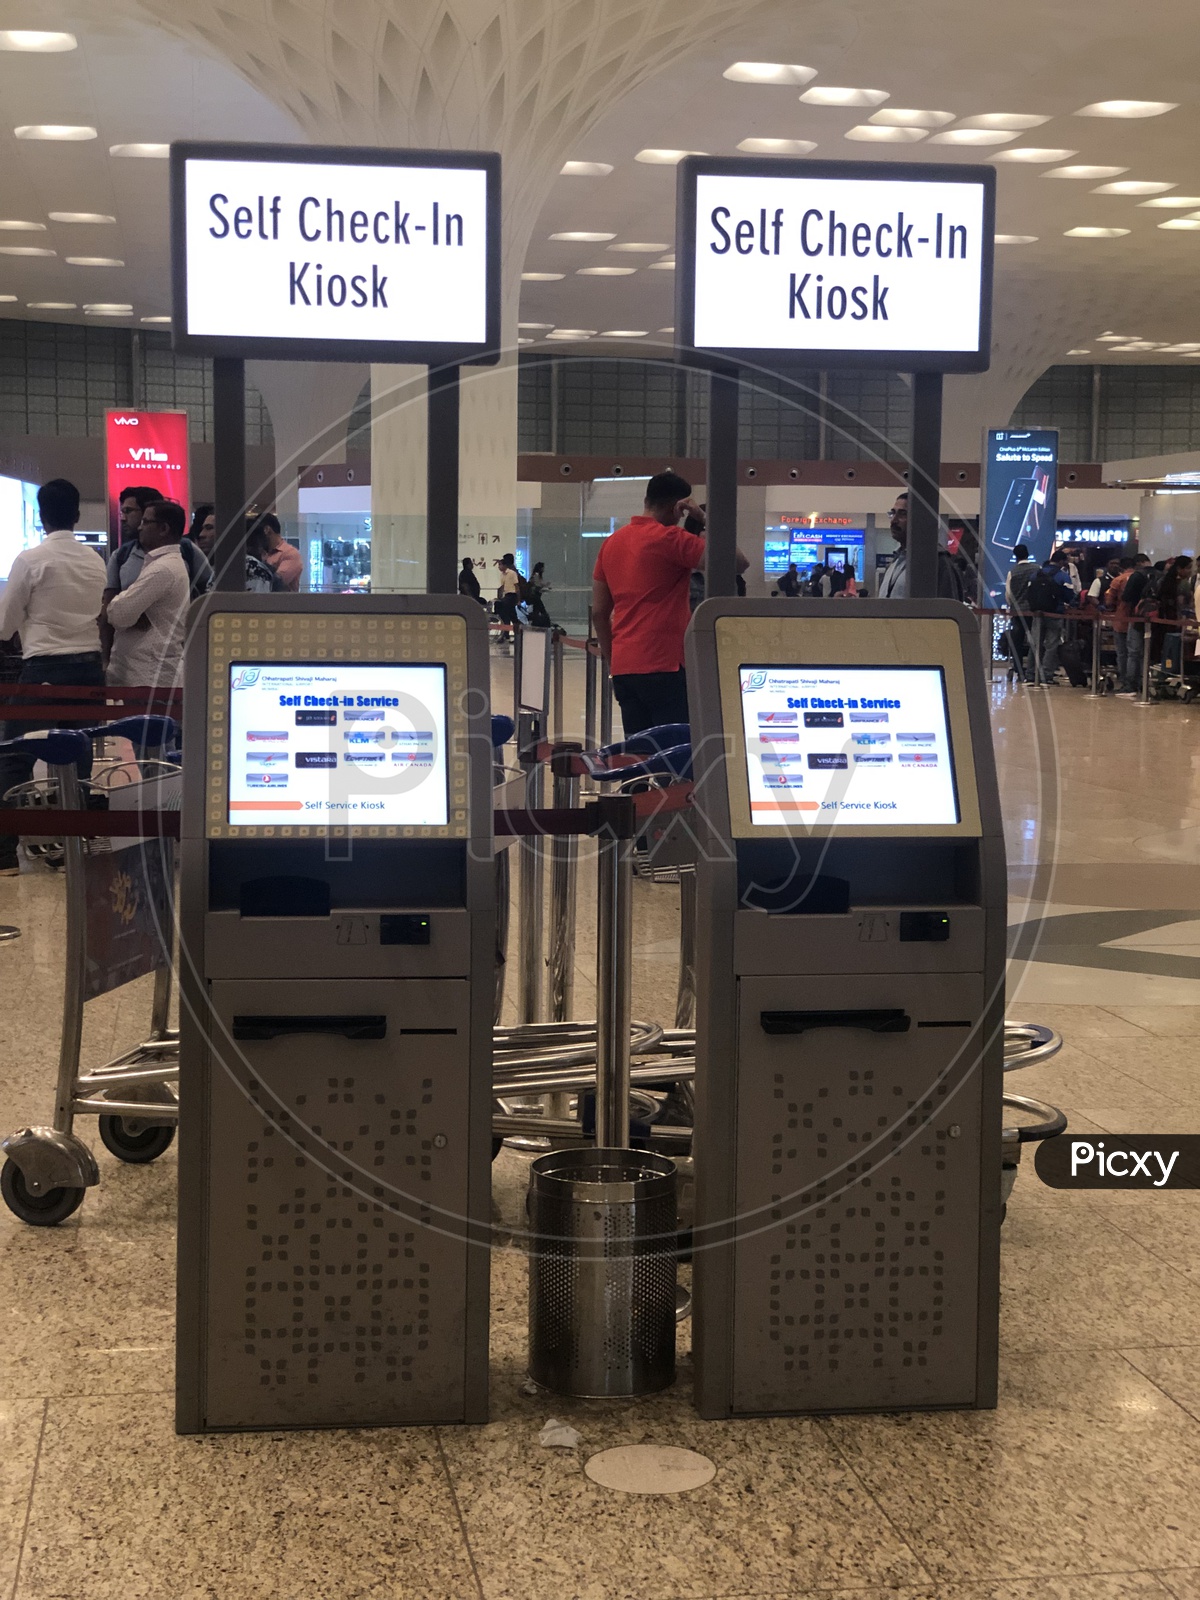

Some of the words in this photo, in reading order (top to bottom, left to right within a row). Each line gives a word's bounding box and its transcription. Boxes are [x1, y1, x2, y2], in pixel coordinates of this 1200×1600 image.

[208, 193, 281, 240] Self
[298, 196, 464, 246] Check-In
[709, 206, 784, 255] Self
[799, 208, 968, 259] Check-In
[289, 261, 388, 308] Kiosk
[788, 273, 890, 321] Kiosk
[995, 453, 1021, 462] Salute
[1022, 453, 1031, 462] to
[1031, 453, 1053, 463] Speed
[279, 695, 302, 706] Self
[304, 695, 355, 707] Check-in
[357, 695, 399, 707] Service
[787, 697, 808, 709] Self
[811, 697, 858, 709] Check-in
[860, 697, 901, 709] Service
[305, 801, 322, 810] Self
[325, 801, 358, 810] Service
[361, 801, 385, 810] Kiosk
[821, 801, 838, 810] Self
[840, 801, 872, 810] Service
[873, 801, 898, 810] Kiosk
